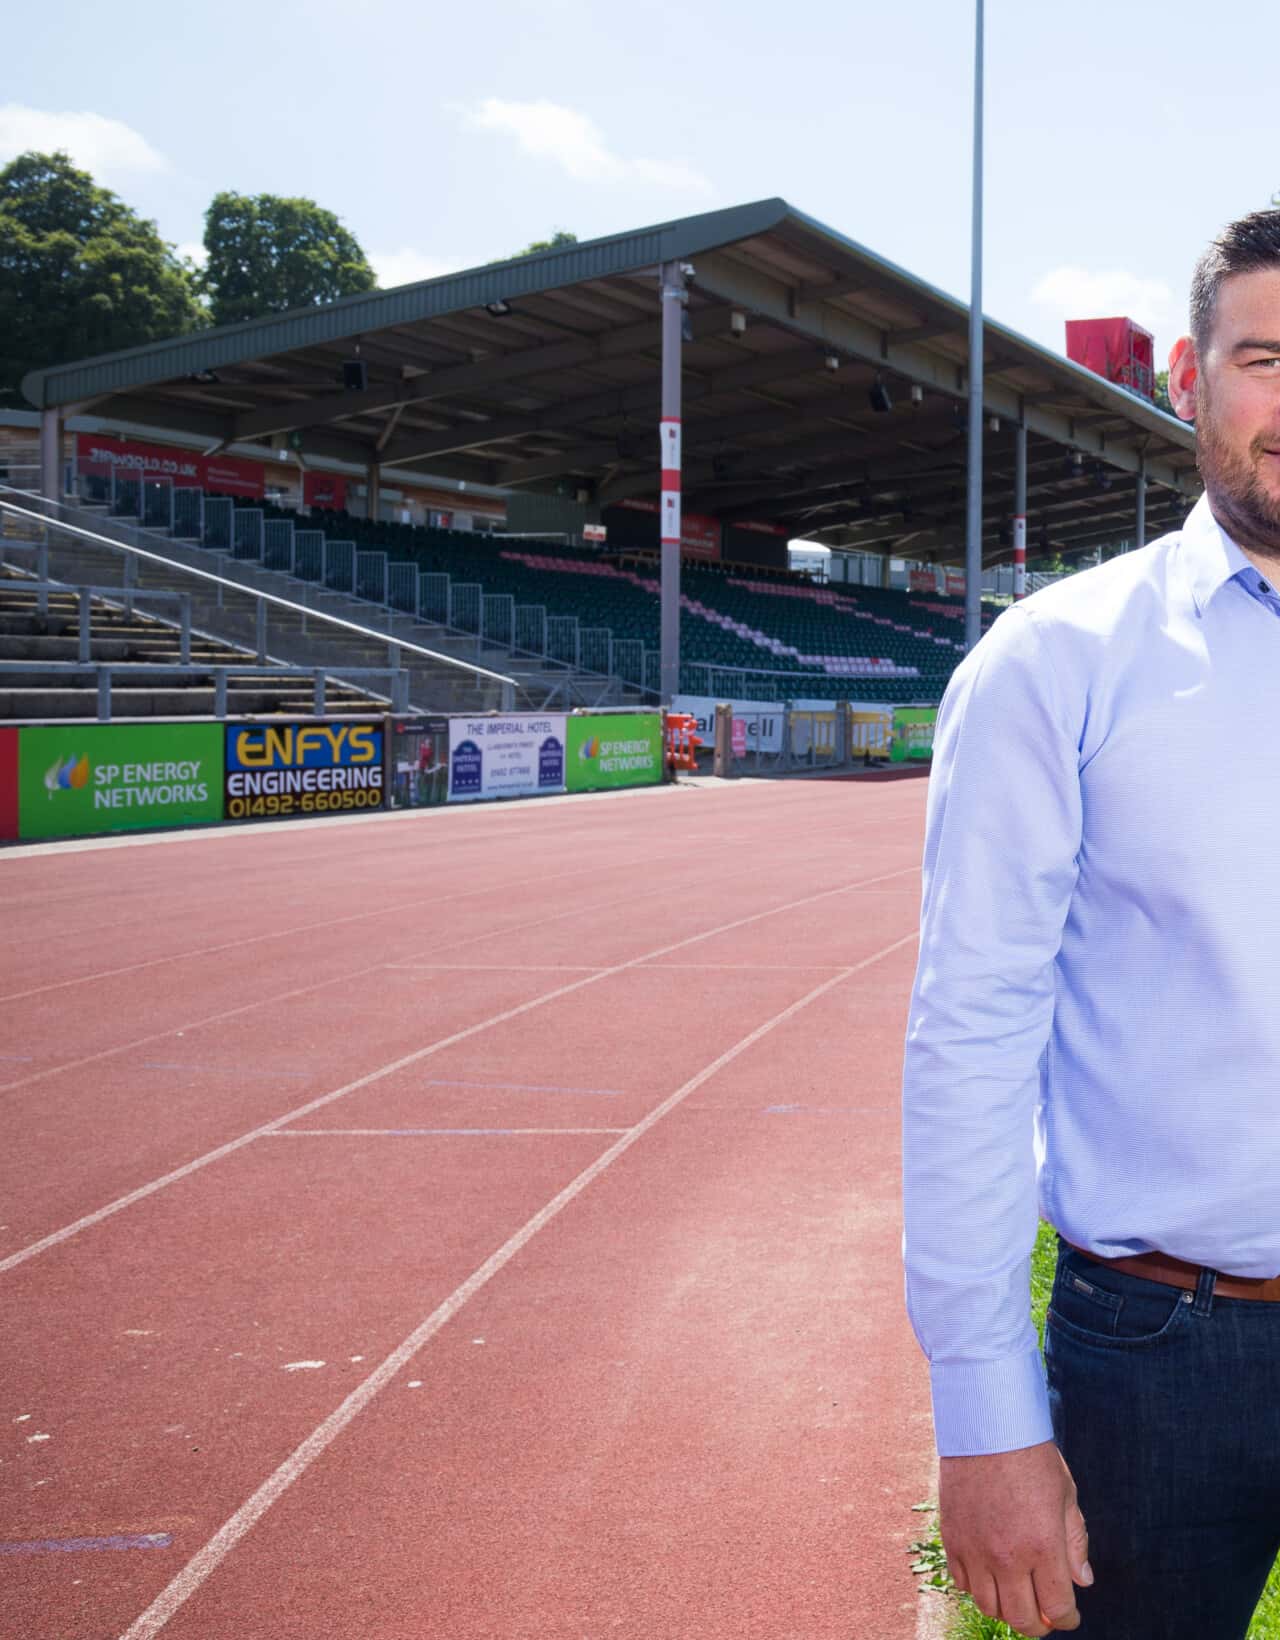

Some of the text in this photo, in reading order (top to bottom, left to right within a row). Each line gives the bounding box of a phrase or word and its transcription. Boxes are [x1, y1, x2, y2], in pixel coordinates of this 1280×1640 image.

[467, 721, 552, 736] THE IMPERIAL HOTEL
[236, 726, 375, 767] ENFYS
[600, 739, 650, 756] SP ENERGY
[94, 761, 202, 785] SP ENERGY
[600, 755, 654, 772] NETWORKS
[227, 766, 382, 797] ENGINEERING
[94, 783, 208, 809] NETWORKS
